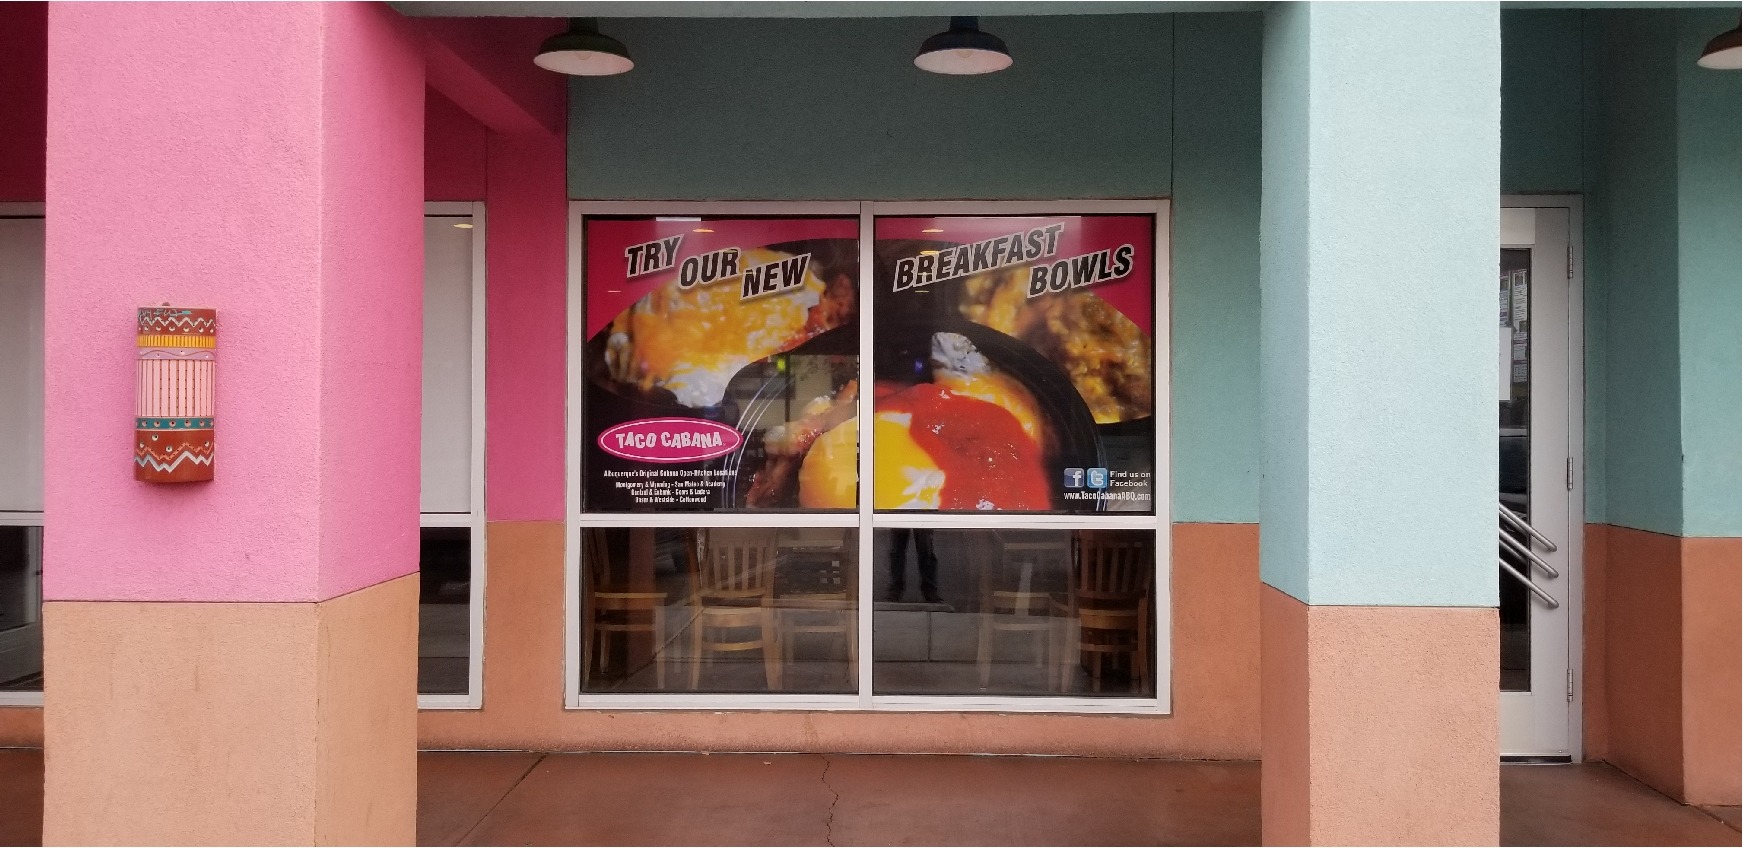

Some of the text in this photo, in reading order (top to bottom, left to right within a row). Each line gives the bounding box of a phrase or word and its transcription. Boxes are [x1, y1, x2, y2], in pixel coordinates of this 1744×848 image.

[894, 222, 1134, 298] BREAKFAST BOWLS
[625, 235, 811, 300] TRY OUR NEW
[616, 431, 722, 449] TACO CABANA
[639, 469, 659, 479] Original
[1109, 470, 1127, 478] Find
[1109, 479, 1148, 487] Facebook
